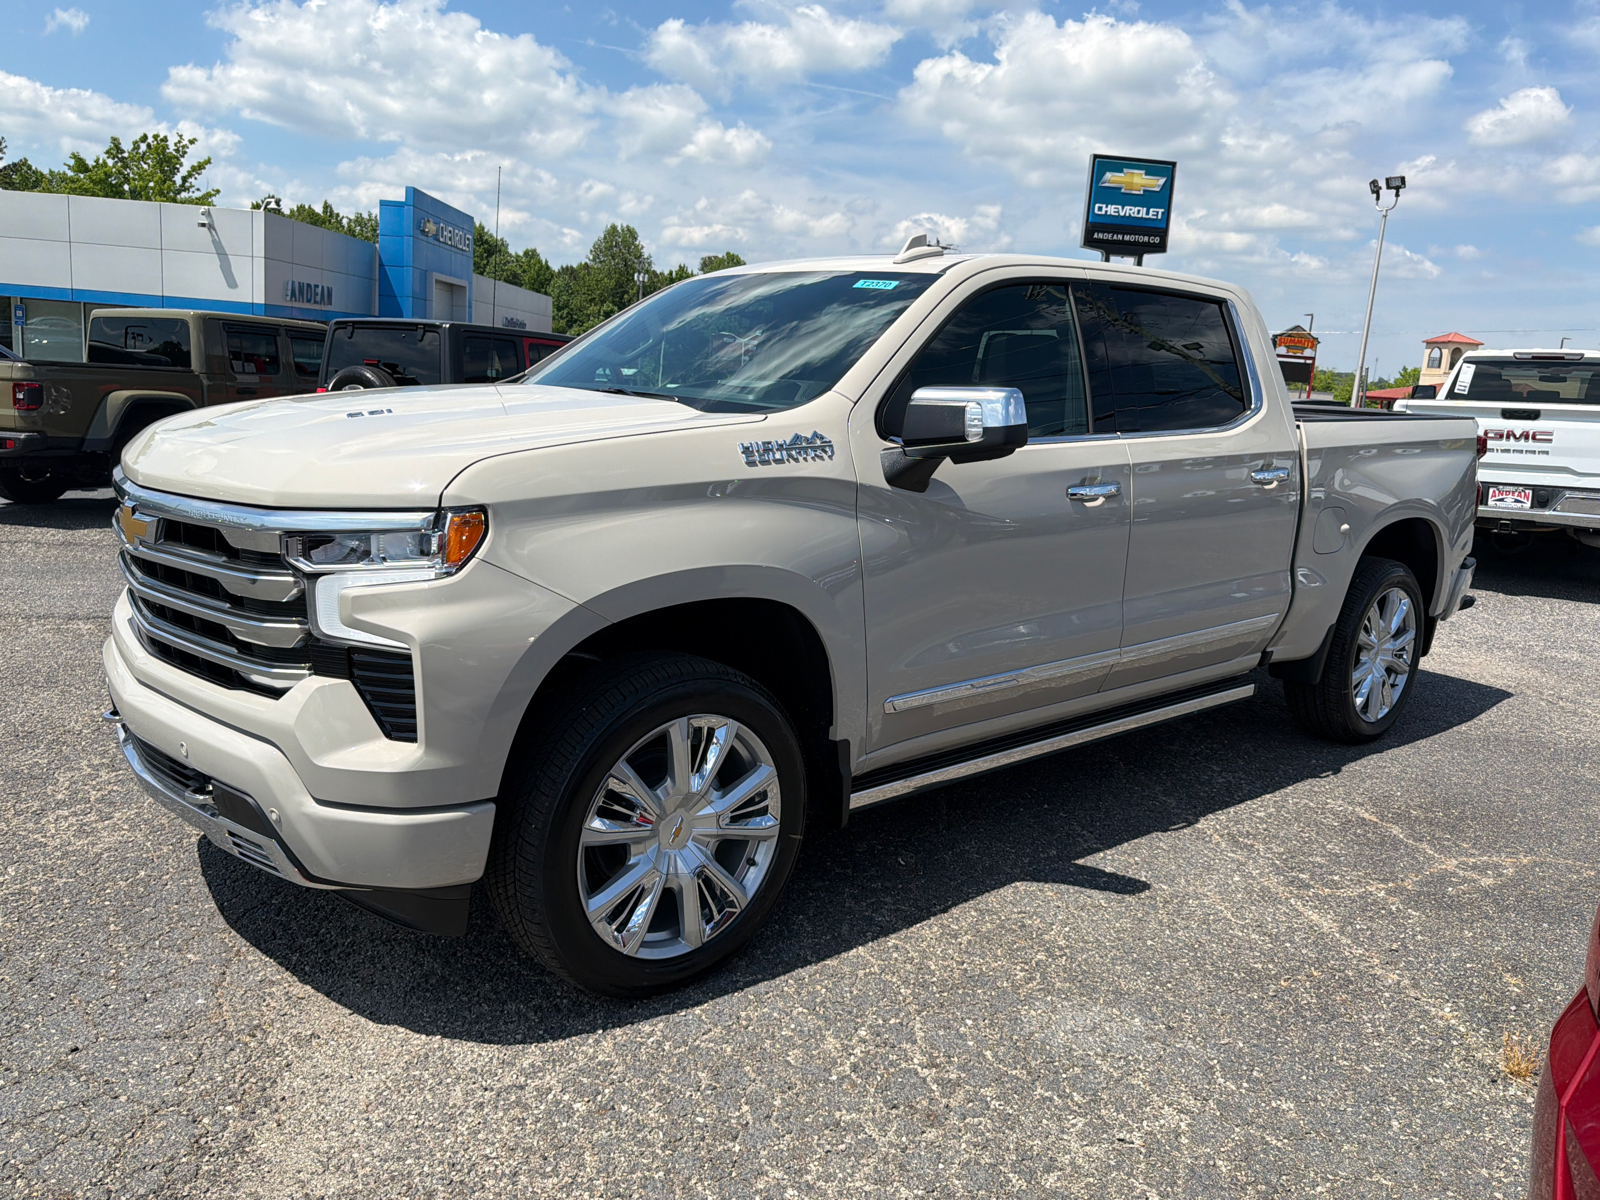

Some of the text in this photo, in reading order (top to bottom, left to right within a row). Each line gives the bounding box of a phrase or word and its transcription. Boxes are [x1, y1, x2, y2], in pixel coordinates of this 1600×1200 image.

[1094, 203, 1164, 219] CHEVROLET
[439, 222, 472, 252] CHEVROLET
[1093, 232, 1122, 240] ANDEAN
[1149, 236, 1160, 244] CO
[288, 280, 333, 306] ANDEAN
[1277, 337, 1316, 351] SUMMITS
[1483, 429, 1554, 444] GMC
[738, 439, 787, 453] HIGH
[743, 448, 834, 464] COUNTRY
[1490, 489, 1530, 502] ANDEAN
